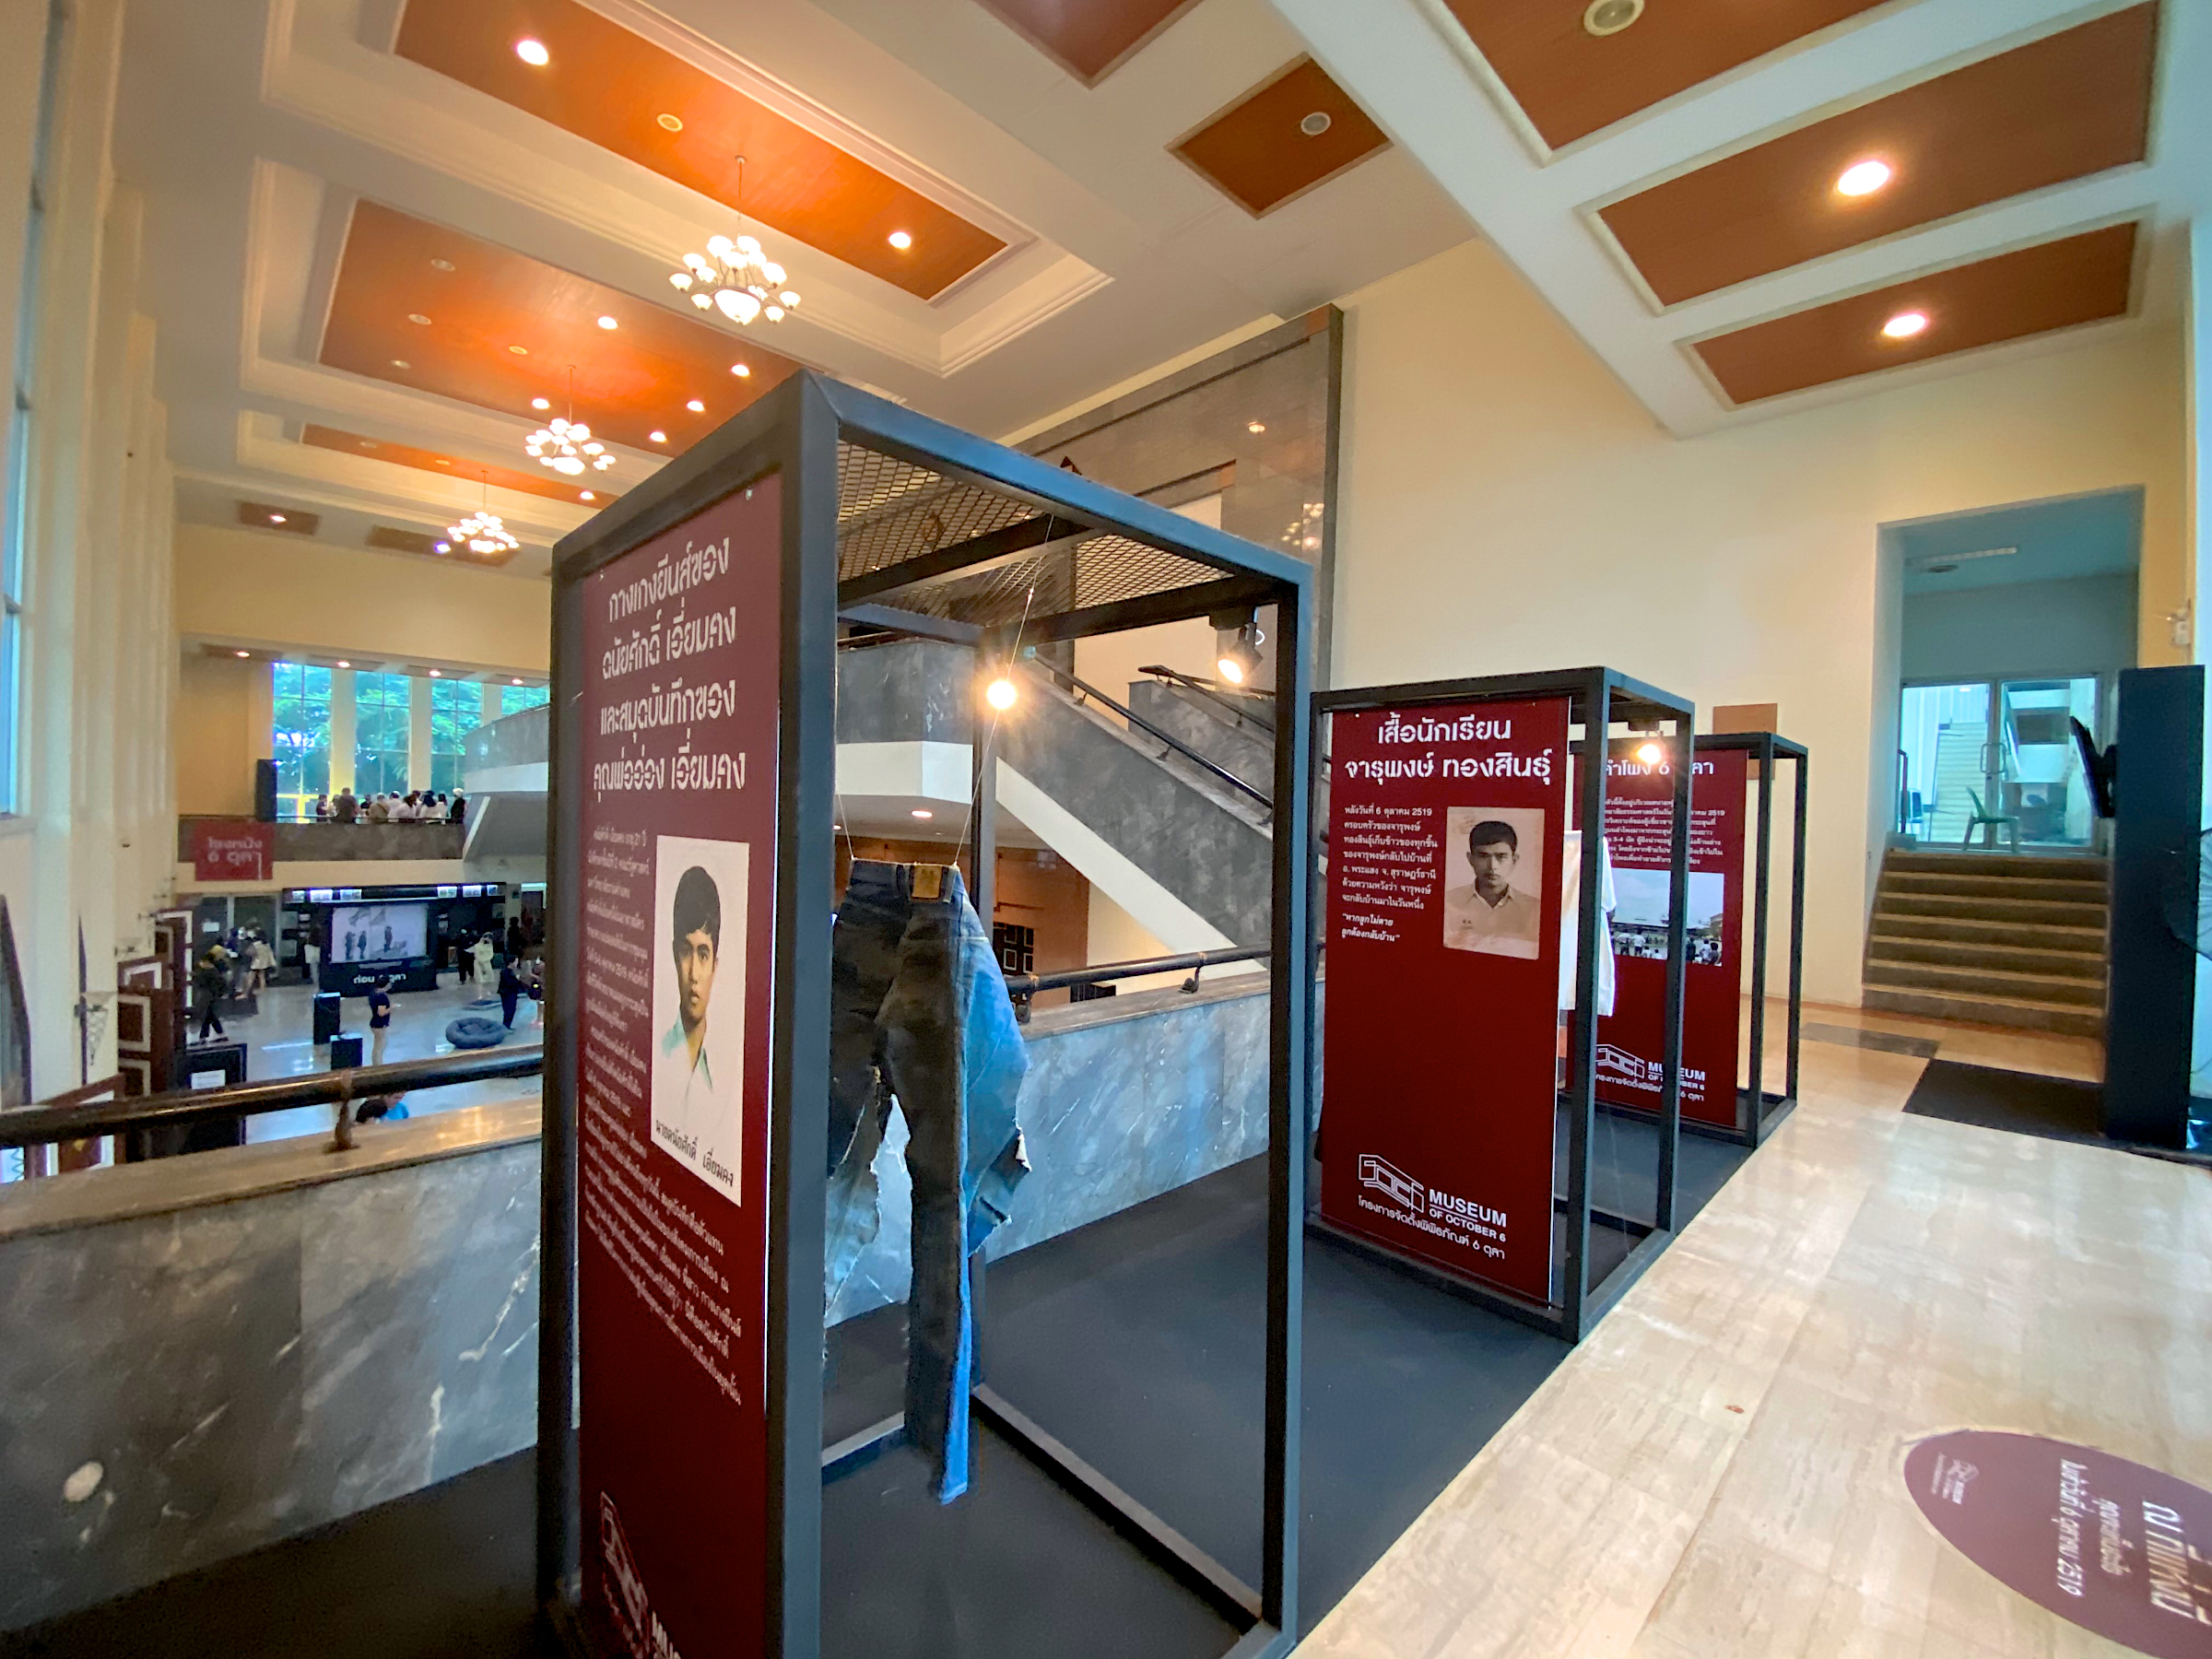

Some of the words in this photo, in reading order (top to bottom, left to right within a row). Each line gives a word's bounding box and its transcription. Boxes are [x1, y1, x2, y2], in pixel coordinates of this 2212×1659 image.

[608, 537, 730, 622] กางเกงยีนส์ของ
[602, 608, 663, 680] ดนัยศักดิ์
[665, 596, 736, 662] เอี่ยมคง
[600, 677, 735, 744] และสมุดบันทึกของ
[1378, 712, 1512, 745] เสื้อนักเรียน
[593, 744, 665, 804] คุณพ่ออ่อง
[670, 727, 746, 790] เอี่ยมคง
[1345, 752, 1434, 785] จารุพงษ์
[1442, 748, 1552, 785] ทองสินธุ์
[1658, 761, 1670, 775] 6
[1375, 806, 1382, 816] 6
[1383, 807, 1410, 819] ตุลาคม
[1412, 807, 1432, 817] 2519
[702, 1147, 734, 1187] เอี่ยมคง
[1358, 1194, 1469, 1247] โครงการจัดตั้งพิพิธภัณฑ์
[1472, 1240, 1480, 1251] 6
[1483, 1243, 1505, 1260] ตุลา
[1429, 1188, 1507, 1228] MUSEUM
[1429, 1207, 1443, 1219] OF
[1445, 1214, 1497, 1240] OCTOBER
[1499, 1232, 1506, 1242] 6
[2060, 1507, 2083, 1518] 6
[2057, 1558, 2084, 1596] 2519
